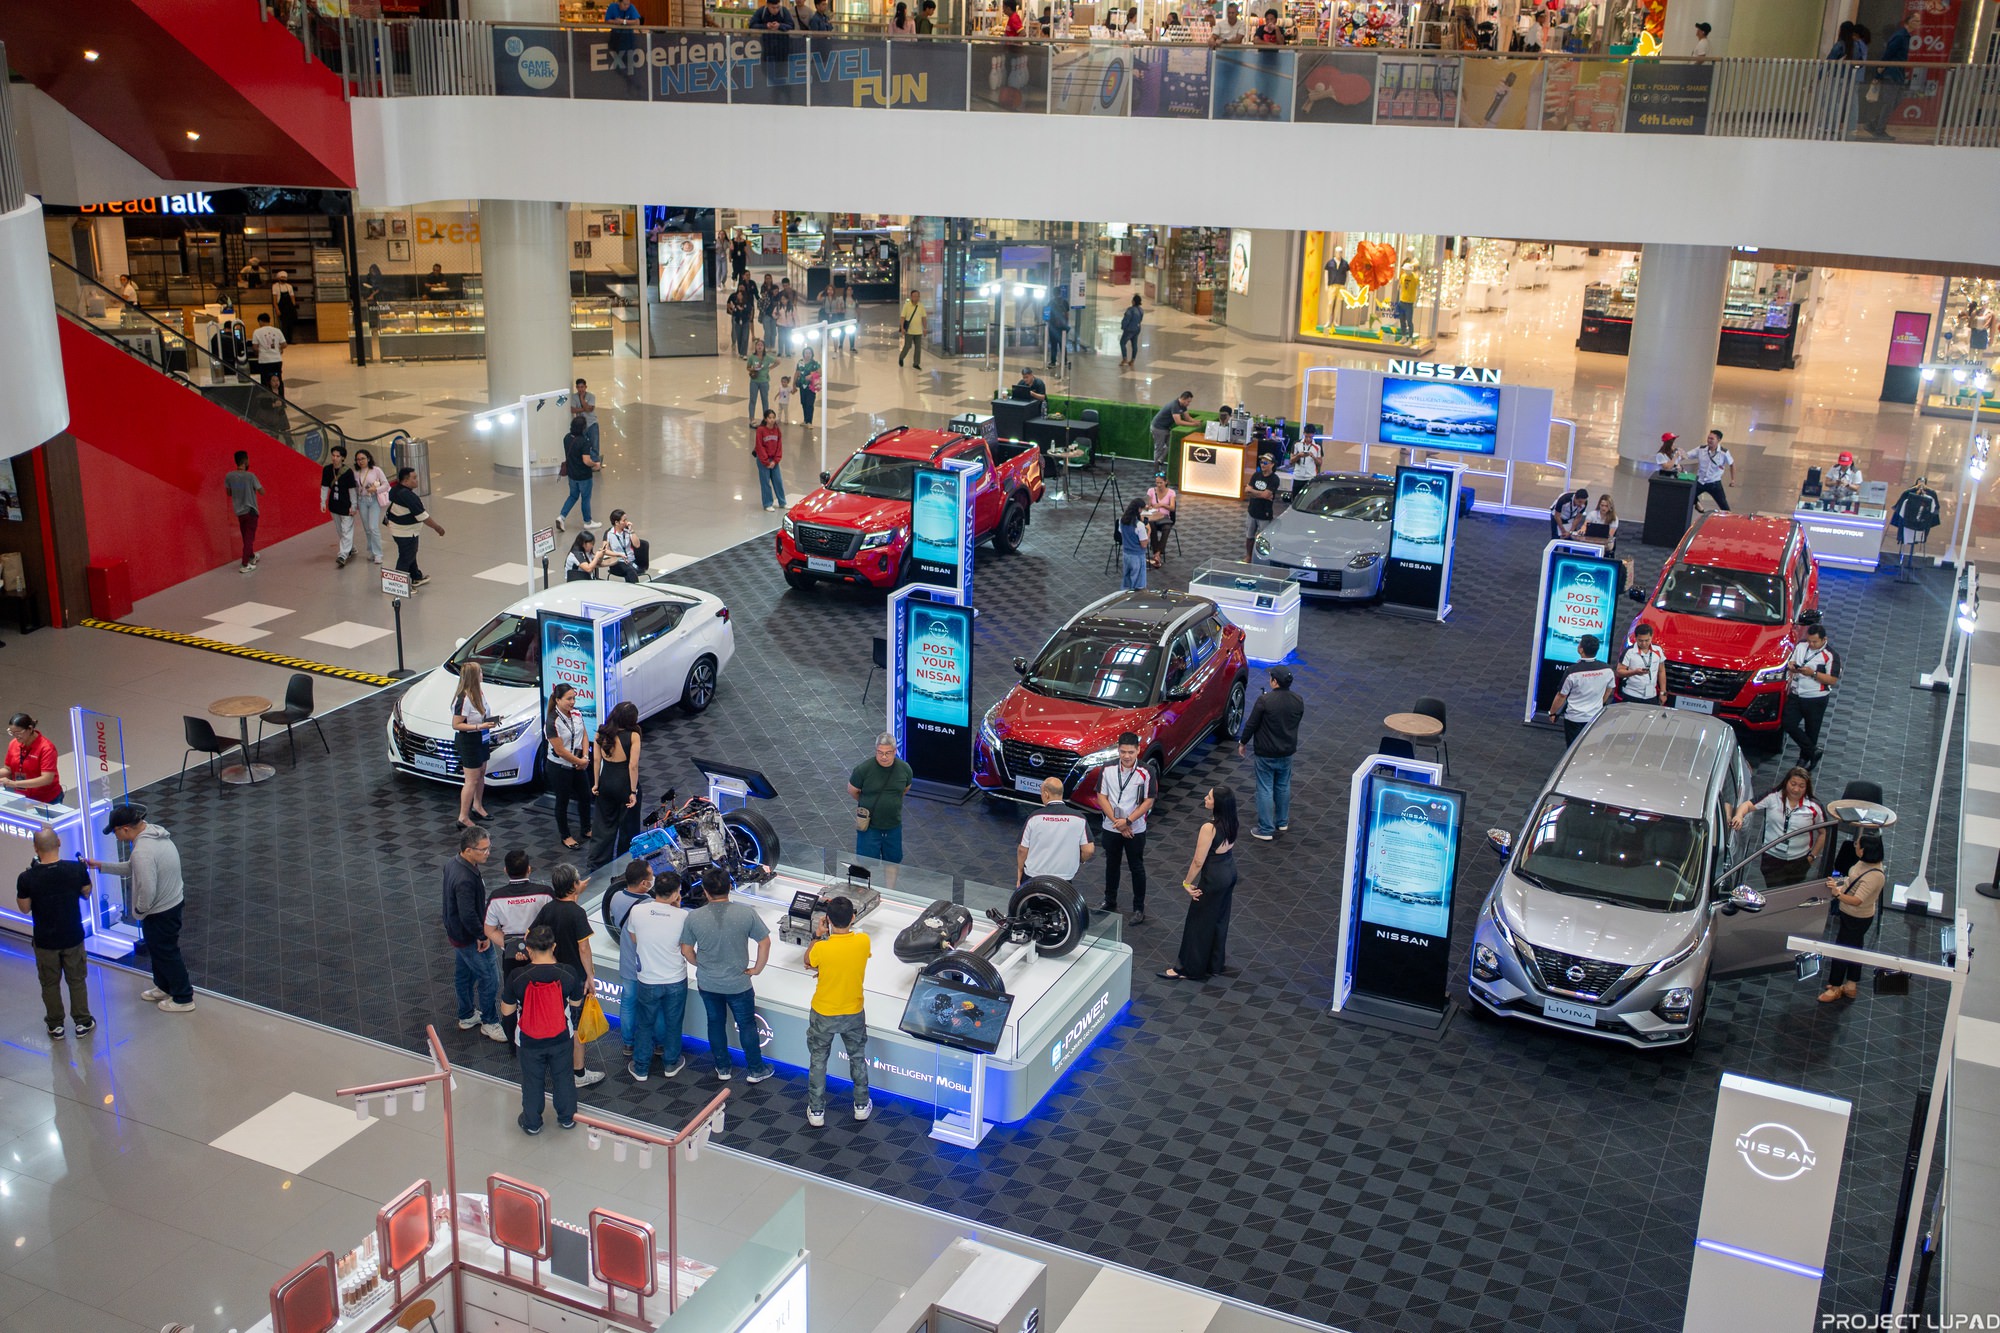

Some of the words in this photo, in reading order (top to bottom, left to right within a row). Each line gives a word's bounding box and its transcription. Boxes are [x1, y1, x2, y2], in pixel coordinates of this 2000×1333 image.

[590, 36, 762, 76] Experience
[521, 59, 550, 70] GAME
[528, 68, 555, 78] PARK
[660, 58, 761, 96] NEXT
[767, 48, 882, 87] LEVEL
[853, 72, 928, 107] FUN
[1638, 113, 1660, 125] 4th
[1661, 114, 1694, 127] Level
[416, 218, 480, 244] Brea
[1388, 358, 1501, 385] NISSAN
[959, 425, 978, 435] TON
[533, 532, 552, 543] CAUTION
[1809, 526, 1832, 534] NISSAN
[1832, 528, 1864, 537] BOUTIQUE
[965, 504, 974, 587] NAVARA
[921, 564, 951, 575] NISSAN
[1400, 561, 1432, 571] NISSAN
[382, 572, 408, 583] CAUTION
[396, 588, 408, 596] STEP
[1567, 592, 1600, 604] POST
[1565, 604, 1599, 616] YOUR
[1244, 624, 1267, 633] MOBILITY
[1558, 615, 1603, 629] NISSAN
[928, 626, 949, 634] NISSAN
[923, 643, 955, 656] POST
[556, 656, 587, 671] POST
[922, 656, 956, 670] YOUR
[556, 670, 588, 685] YOUR
[916, 668, 961, 684] NISSAN
[1681, 701, 1708, 709] TERRA
[917, 722, 956, 736] NISSAN
[95, 721, 108, 772] DARING
[416, 759, 445, 770] ALMERA
[101, 775, 110, 801] AYS
[1020, 779, 1042, 788] KICK
[1400, 811, 1429, 821] NISSAN
[0, 823, 34, 839] NISSA
[507, 897, 536, 905] NISSAN
[1376, 929, 1429, 947] NISSAN
[1548, 1005, 1592, 1020] LIVINA
[873, 1056, 933, 1083] INTELLIGENT
[1735, 1137, 1817, 1166] NISSAN
